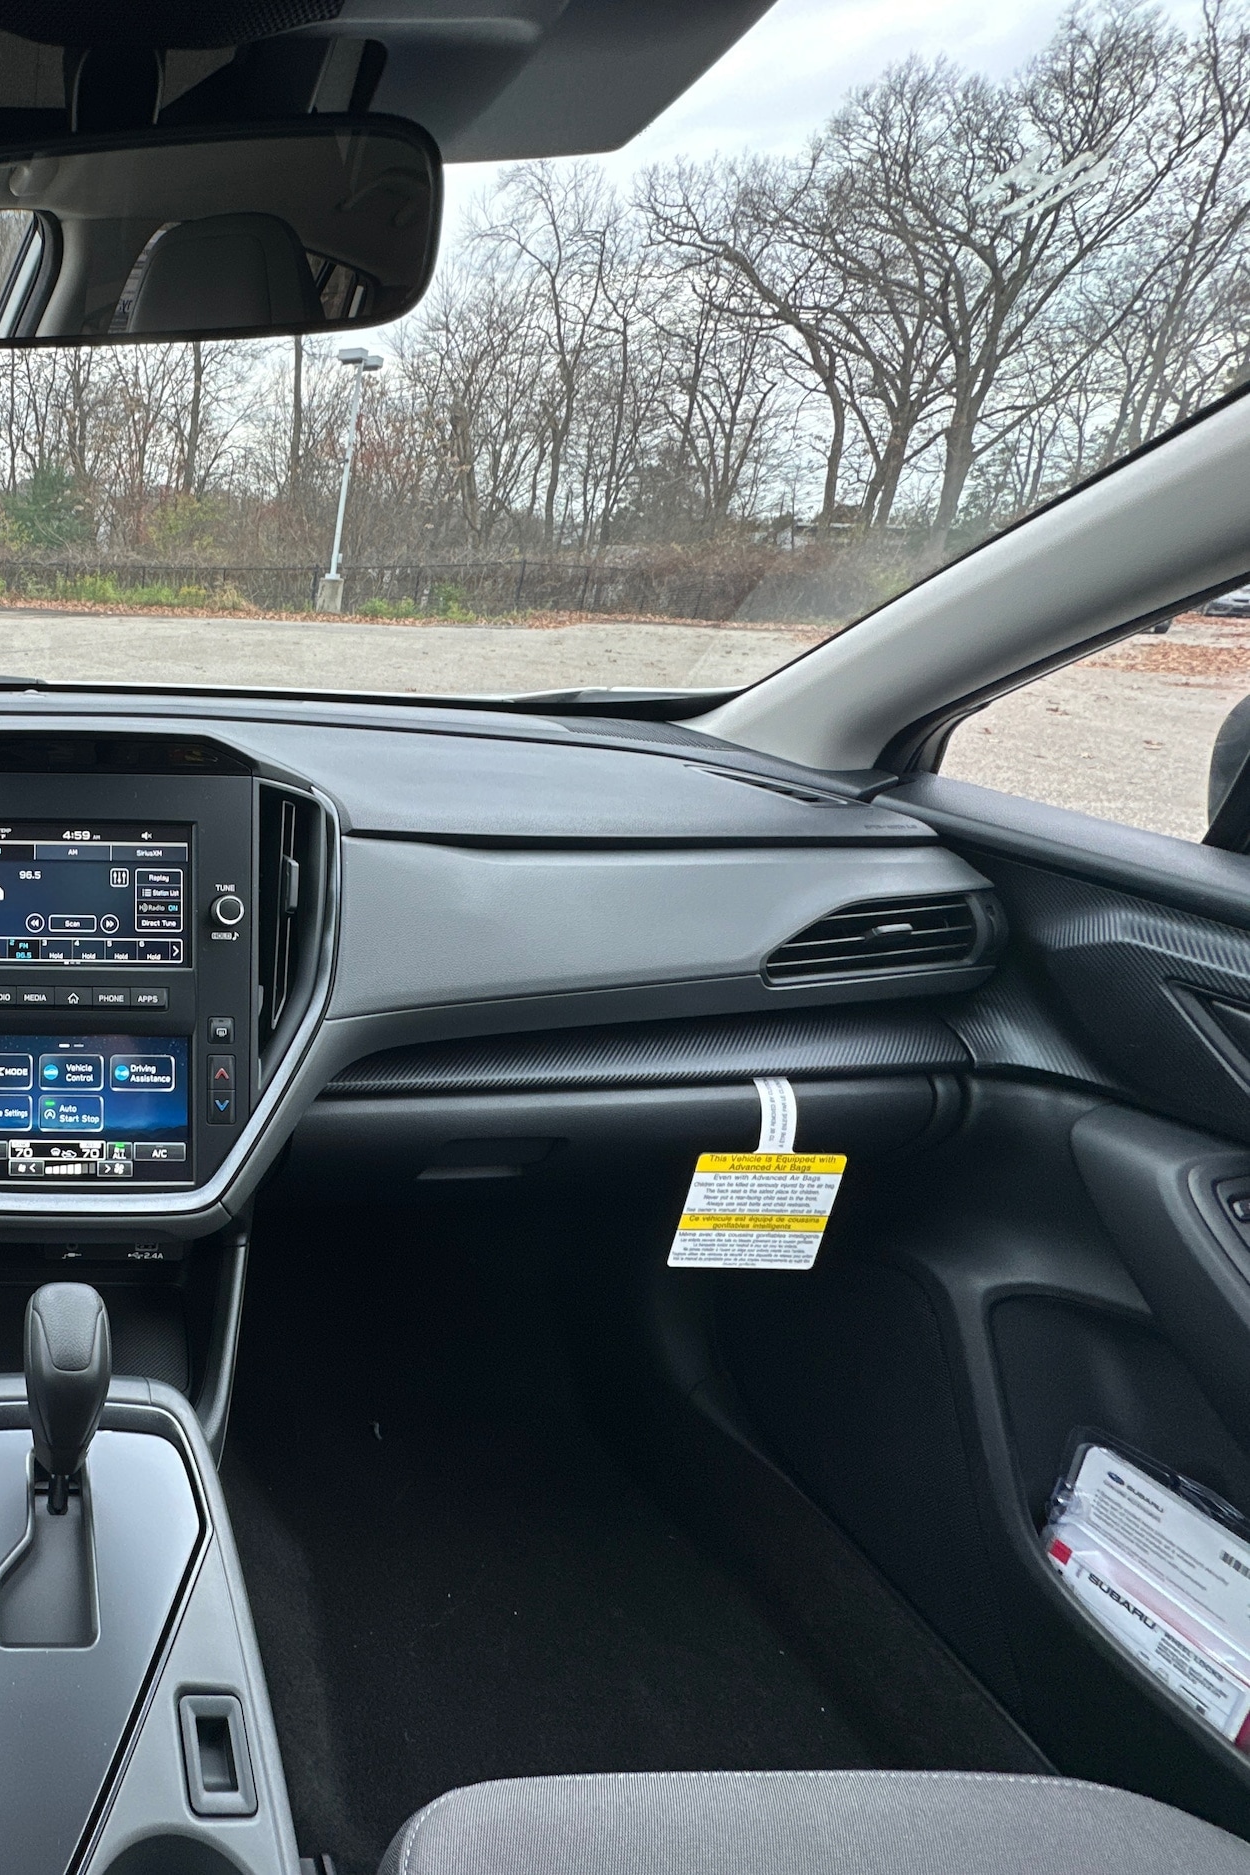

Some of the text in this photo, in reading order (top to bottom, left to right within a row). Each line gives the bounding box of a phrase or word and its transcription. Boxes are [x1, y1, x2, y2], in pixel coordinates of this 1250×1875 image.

[62, 830, 90, 840] 4:59
[19, 870, 42, 880] 96.5
[149, 874, 169, 883] Replay
[81, 952, 96, 960] Hold
[146, 953, 161, 961] Hold
[24, 994, 47, 1002] MEDIA
[98, 994, 124, 1003] PHONE
[138, 995, 158, 1004] APPS
[65, 1063, 93, 1072] Vehicle
[130, 1065, 156, 1074] Driving
[65, 1073, 94, 1082] Control
[130, 1075, 171, 1083] Assistance
[4, 1109, 28, 1119] Settings
[59, 1115, 100, 1124] Start Stop
[15, 1148, 33, 1158] 70
[82, 1148, 100, 1158] 70
[152, 1150, 168, 1158] A/C
[710, 1154, 727, 1162] This
[731, 1154, 761, 1162] Vehicle
[776, 1155, 815, 1164] Equipped
[729, 1163, 772, 1171] Advanced
[790, 1164, 811, 1173] Bags
[144, 1252, 164, 1260] 2.4A
[1126, 1485, 1164, 1513] SUBARU
[1088, 1573, 1156, 1630] SUBARU
